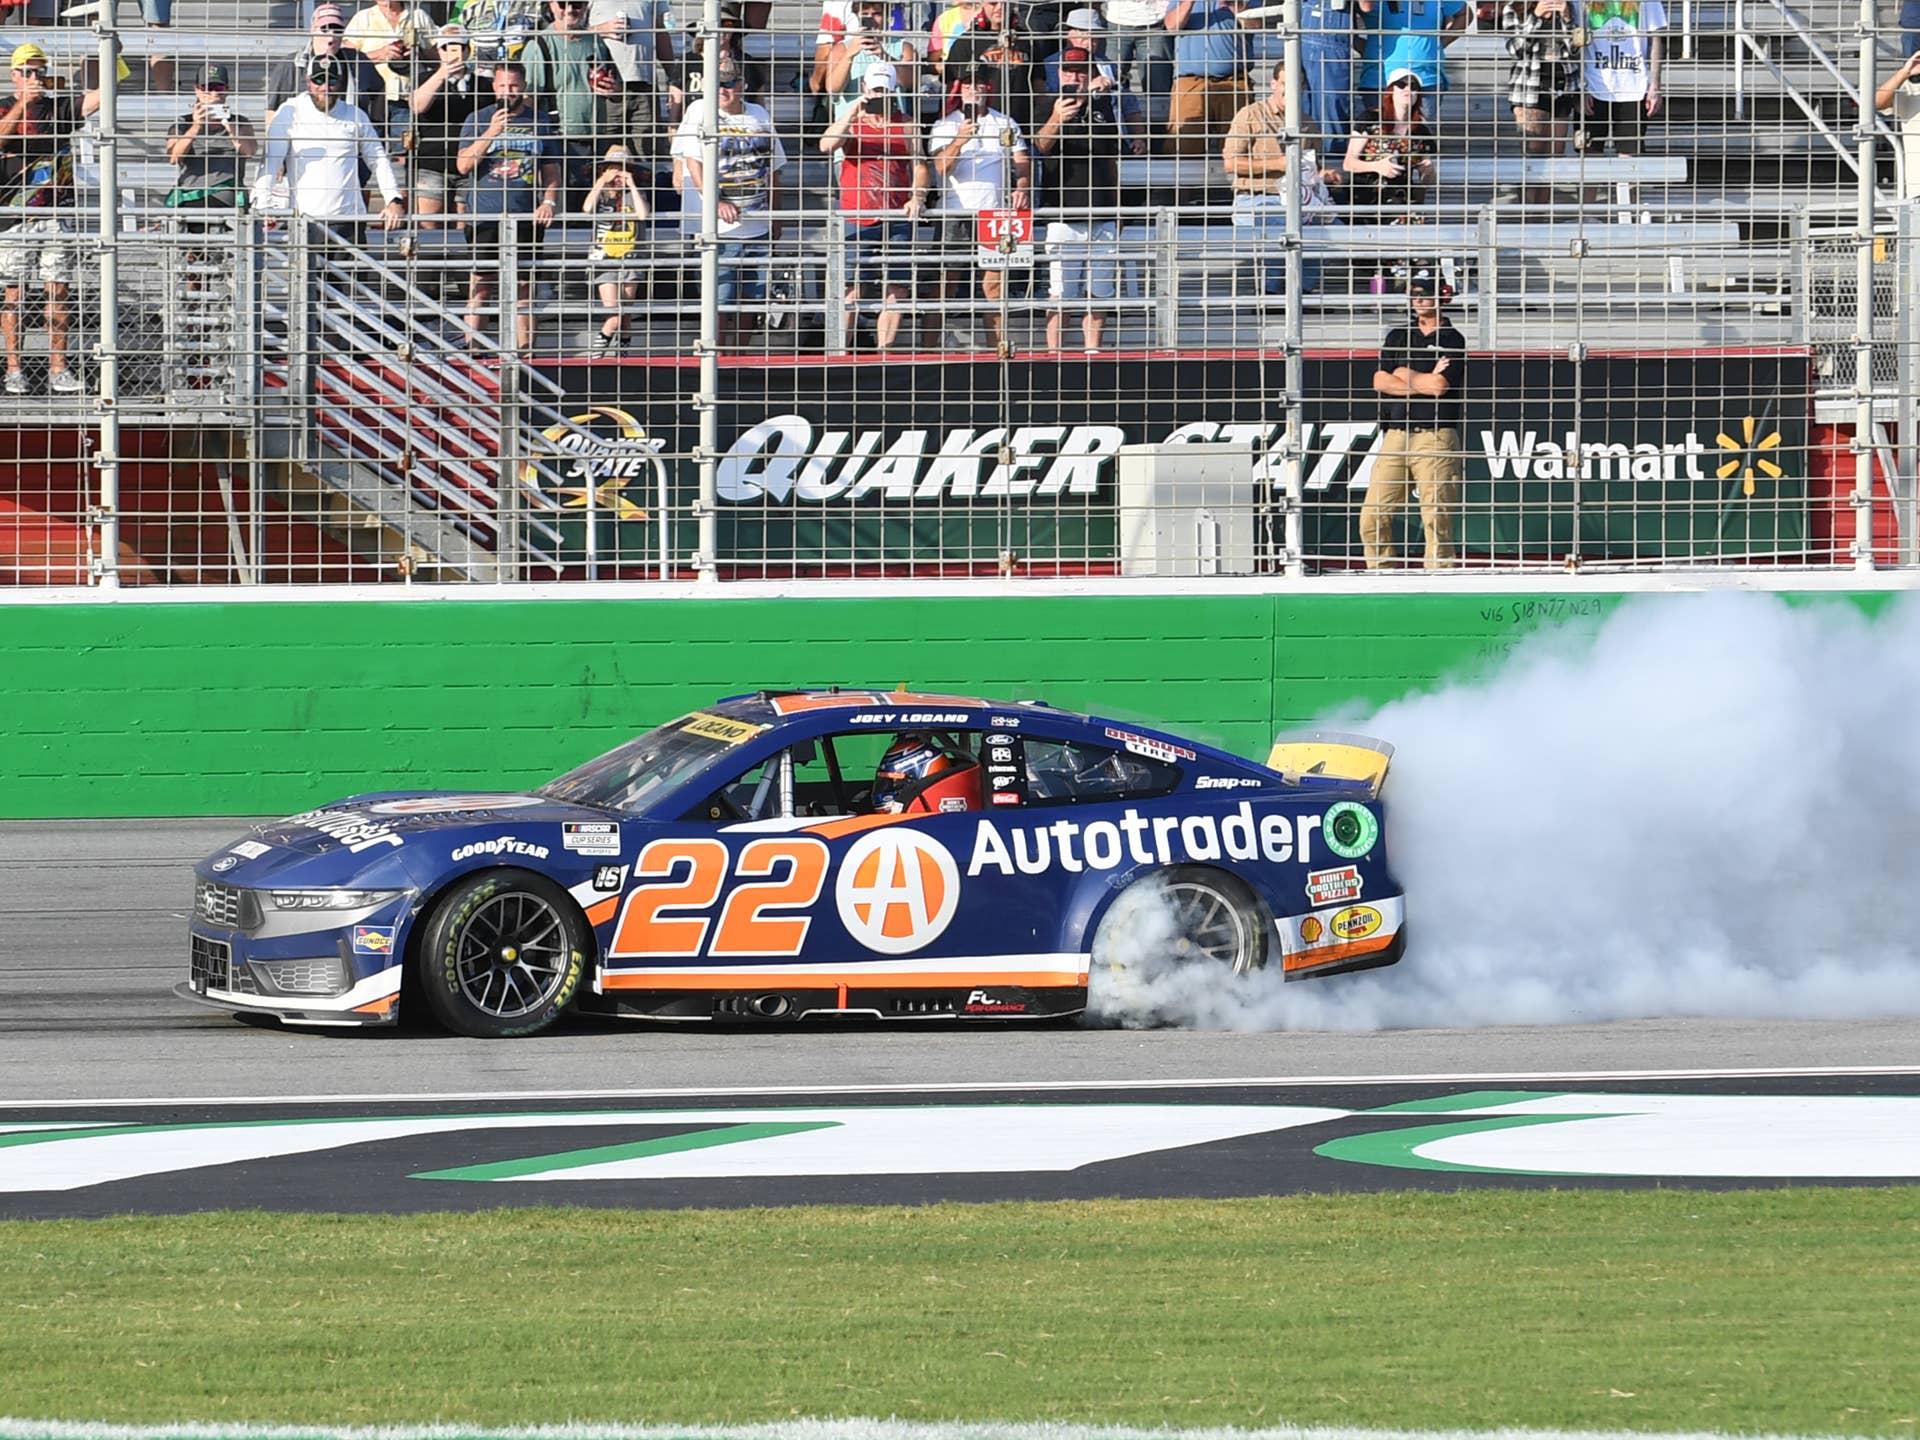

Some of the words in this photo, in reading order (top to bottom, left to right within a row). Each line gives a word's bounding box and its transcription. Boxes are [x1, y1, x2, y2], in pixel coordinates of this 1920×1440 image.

[986, 219, 1024, 238] 143
[716, 414, 1125, 504] QUAKER
[1480, 430, 1705, 480] Walmart
[849, 714, 897, 723] JOEY
[900, 713, 969, 723] LOGANO
[1105, 727, 1196, 760] DISCOUNT
[1132, 743, 1170, 760] TIRE
[1195, 776, 1262, 789] Snap-on
[451, 836, 550, 862] GOODYEAR
[967, 801, 1322, 876] Autotrader
[1310, 878, 1358, 894] BROTHERS
[1319, 871, 1346, 883] HUNT
[608, 838, 831, 958] 22
[1337, 912, 1374, 932] PENNZOIL
[553, 950, 584, 1006] EAGLE
